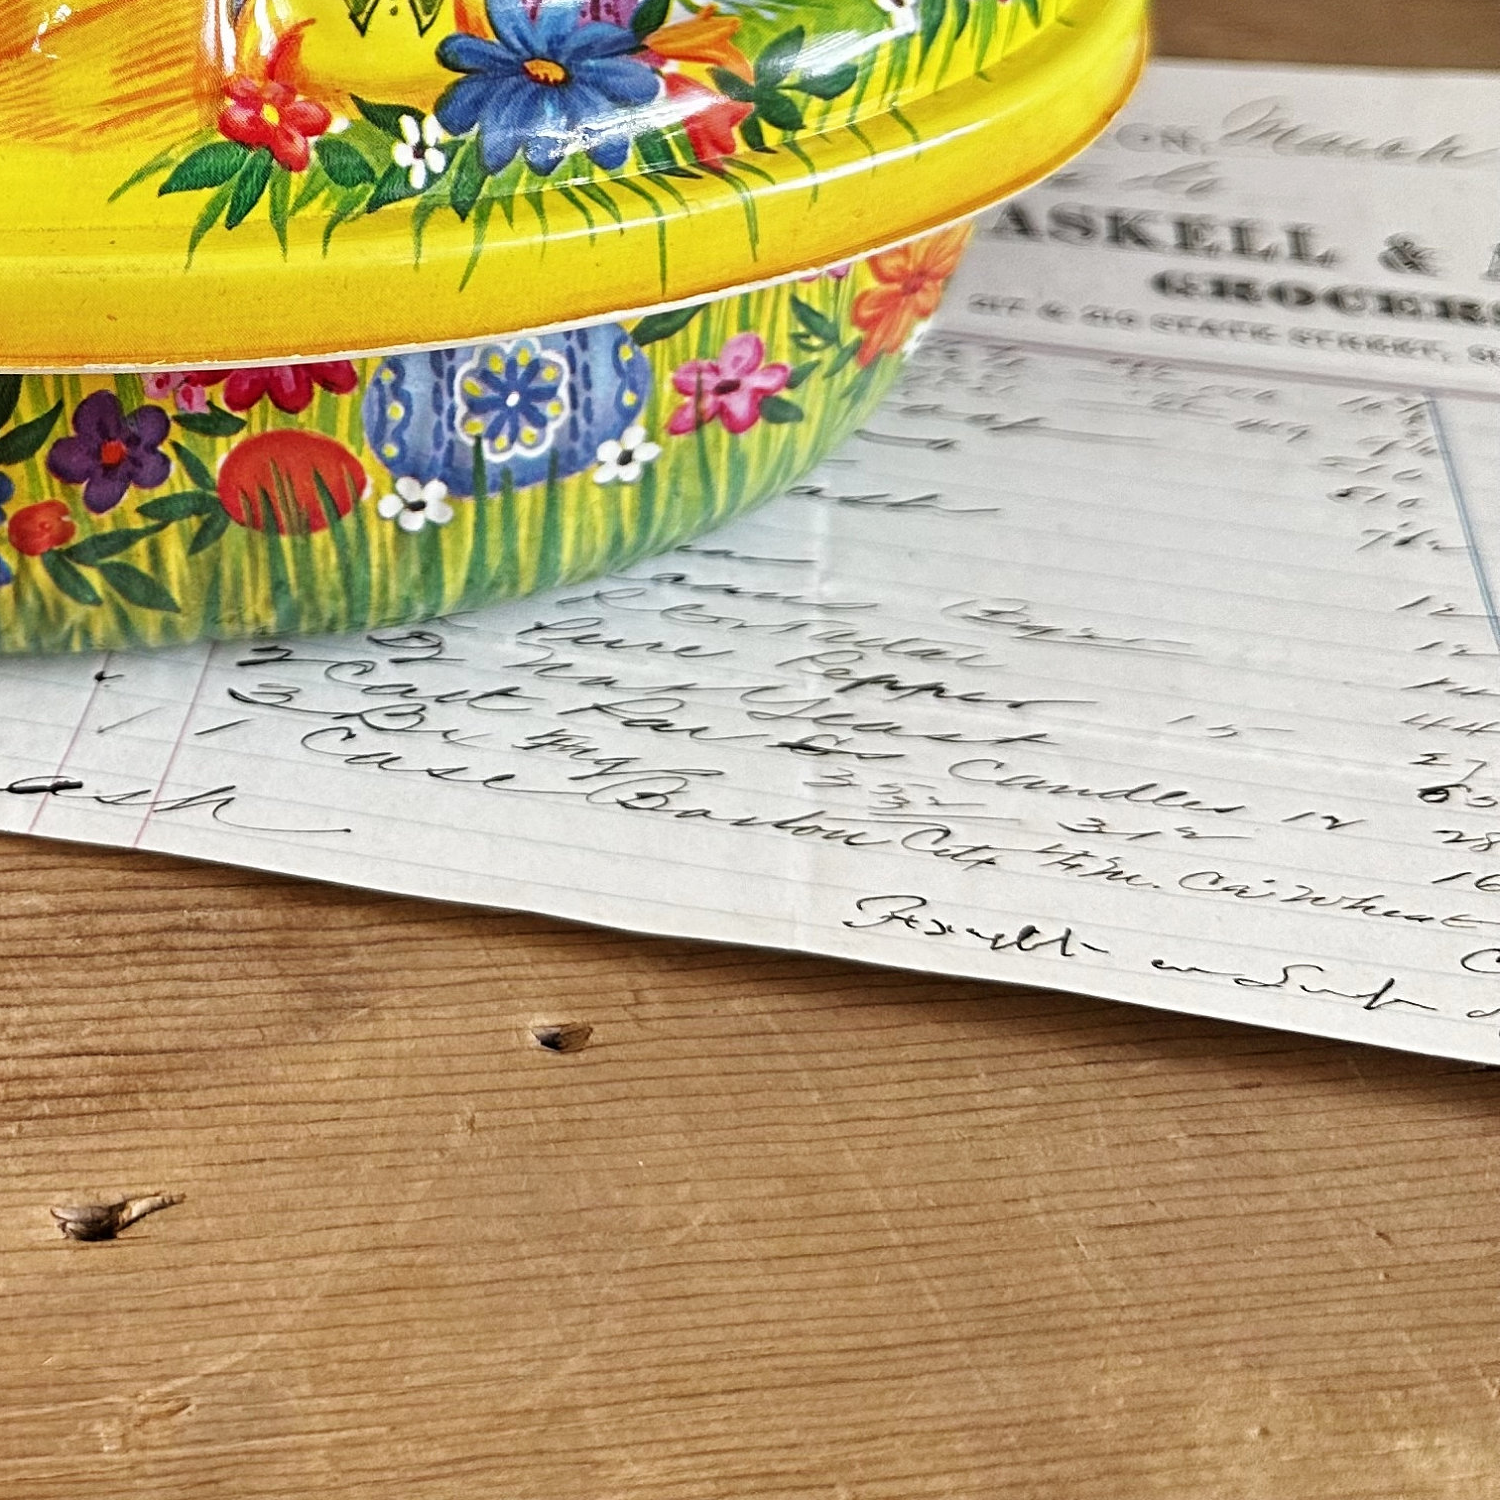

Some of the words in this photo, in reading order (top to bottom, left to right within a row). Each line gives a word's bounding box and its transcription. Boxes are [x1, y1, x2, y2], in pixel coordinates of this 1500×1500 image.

[984, 200, 1342, 268] ASKELL
[1378, 231, 1444, 279] &
[1149, 268, 1500, 328] GROCER
[300, 725, 540, 794] Case
[948, 758, 1246, 816] Candles
